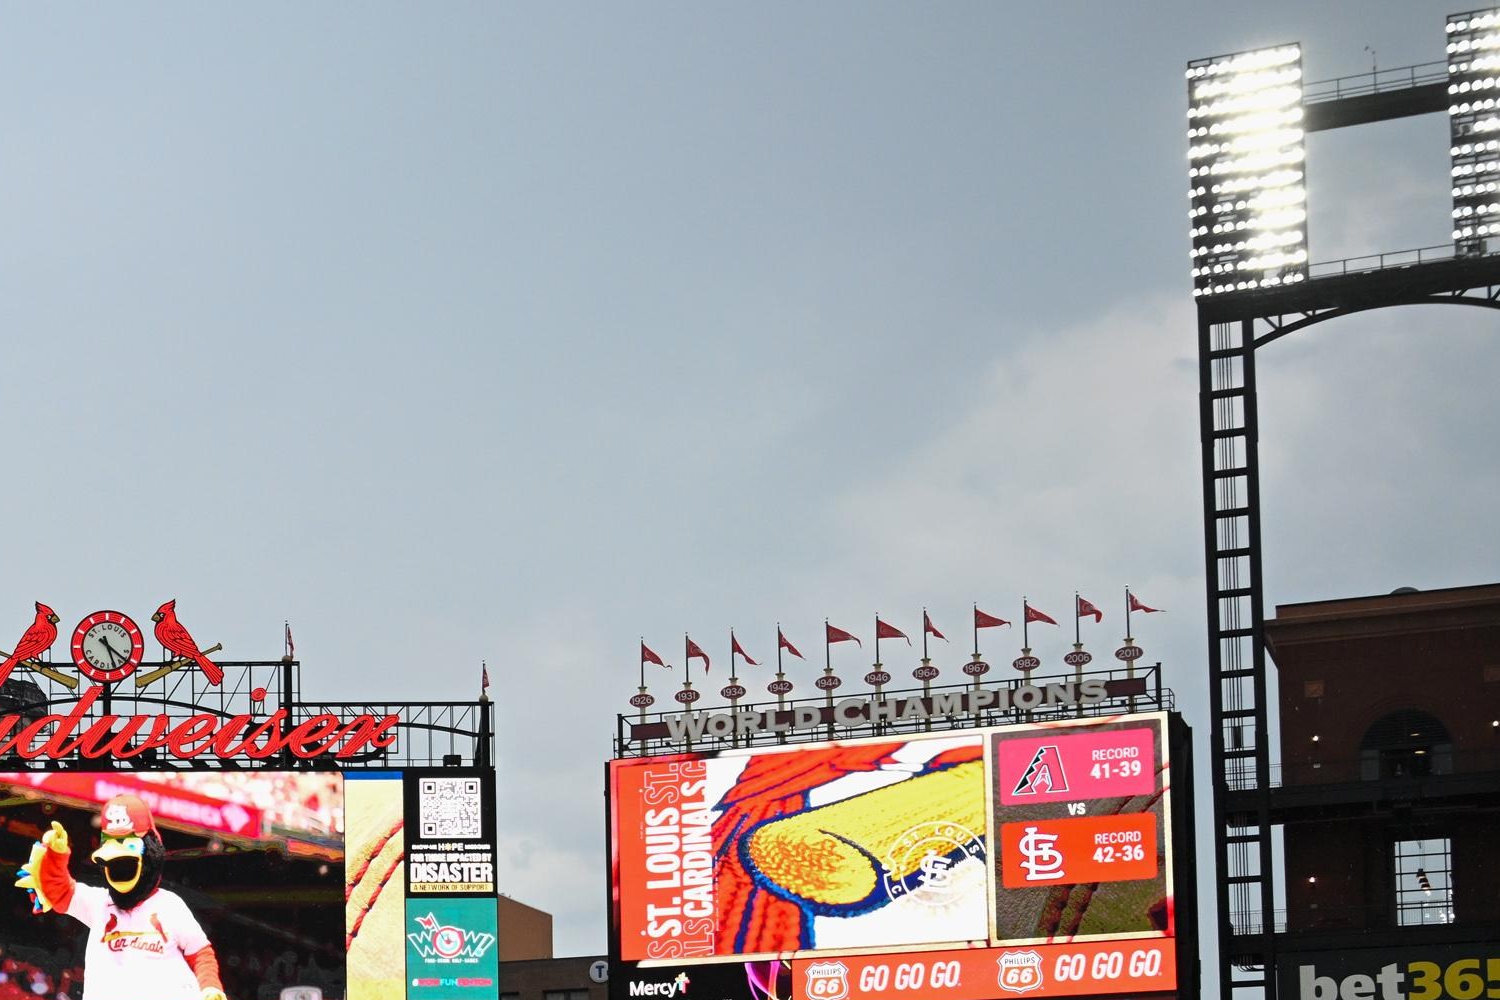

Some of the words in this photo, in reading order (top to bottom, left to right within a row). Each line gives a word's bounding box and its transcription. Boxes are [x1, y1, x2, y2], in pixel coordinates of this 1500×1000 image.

[102, 624, 126, 638] LOUIS
[1066, 654, 1089, 663] 2006
[1118, 648, 1139, 658] 2011
[964, 663, 987, 673] 1967
[1015, 658, 1037, 668] 1982
[866, 673, 888, 682] 1946
[915, 668, 937, 678] 1964
[769, 683, 790, 692] 1942
[818, 678, 839, 687] 1944
[678, 691, 697, 701] 1931
[723, 687, 744, 697] 1934
[631, 696, 652, 705] 1926
[664, 706, 822, 743] WORLD
[833, 679, 1108, 728] CHAMPIONS
[1092, 747, 1139, 760] RECORD
[1090, 761, 1141, 779] 41-39
[935, 826, 980, 854] LOUIS
[1095, 831, 1141, 845] RECORD
[645, 807, 681, 889] LOUIS
[680, 781, 714, 918] CARDINALS
[1093, 845, 1145, 863] 42-36
[410, 863, 493, 883] DISASTER
[108, 936, 164, 954] Cardinals
[1004, 957, 1036, 965] PHILLIPS
[1054, 953, 1086, 982] GO
[1091, 951, 1124, 980] GO
[1129, 949, 1161, 978] GO
[812, 968, 842, 976] PHILLIPS
[859, 965, 890, 992] GO
[894, 962, 925, 990] GO
[930, 960, 961, 989] GO
[1006, 968, 1033, 984] 66
[629, 980, 677, 998] Mercy
[814, 979, 840, 995] 66
